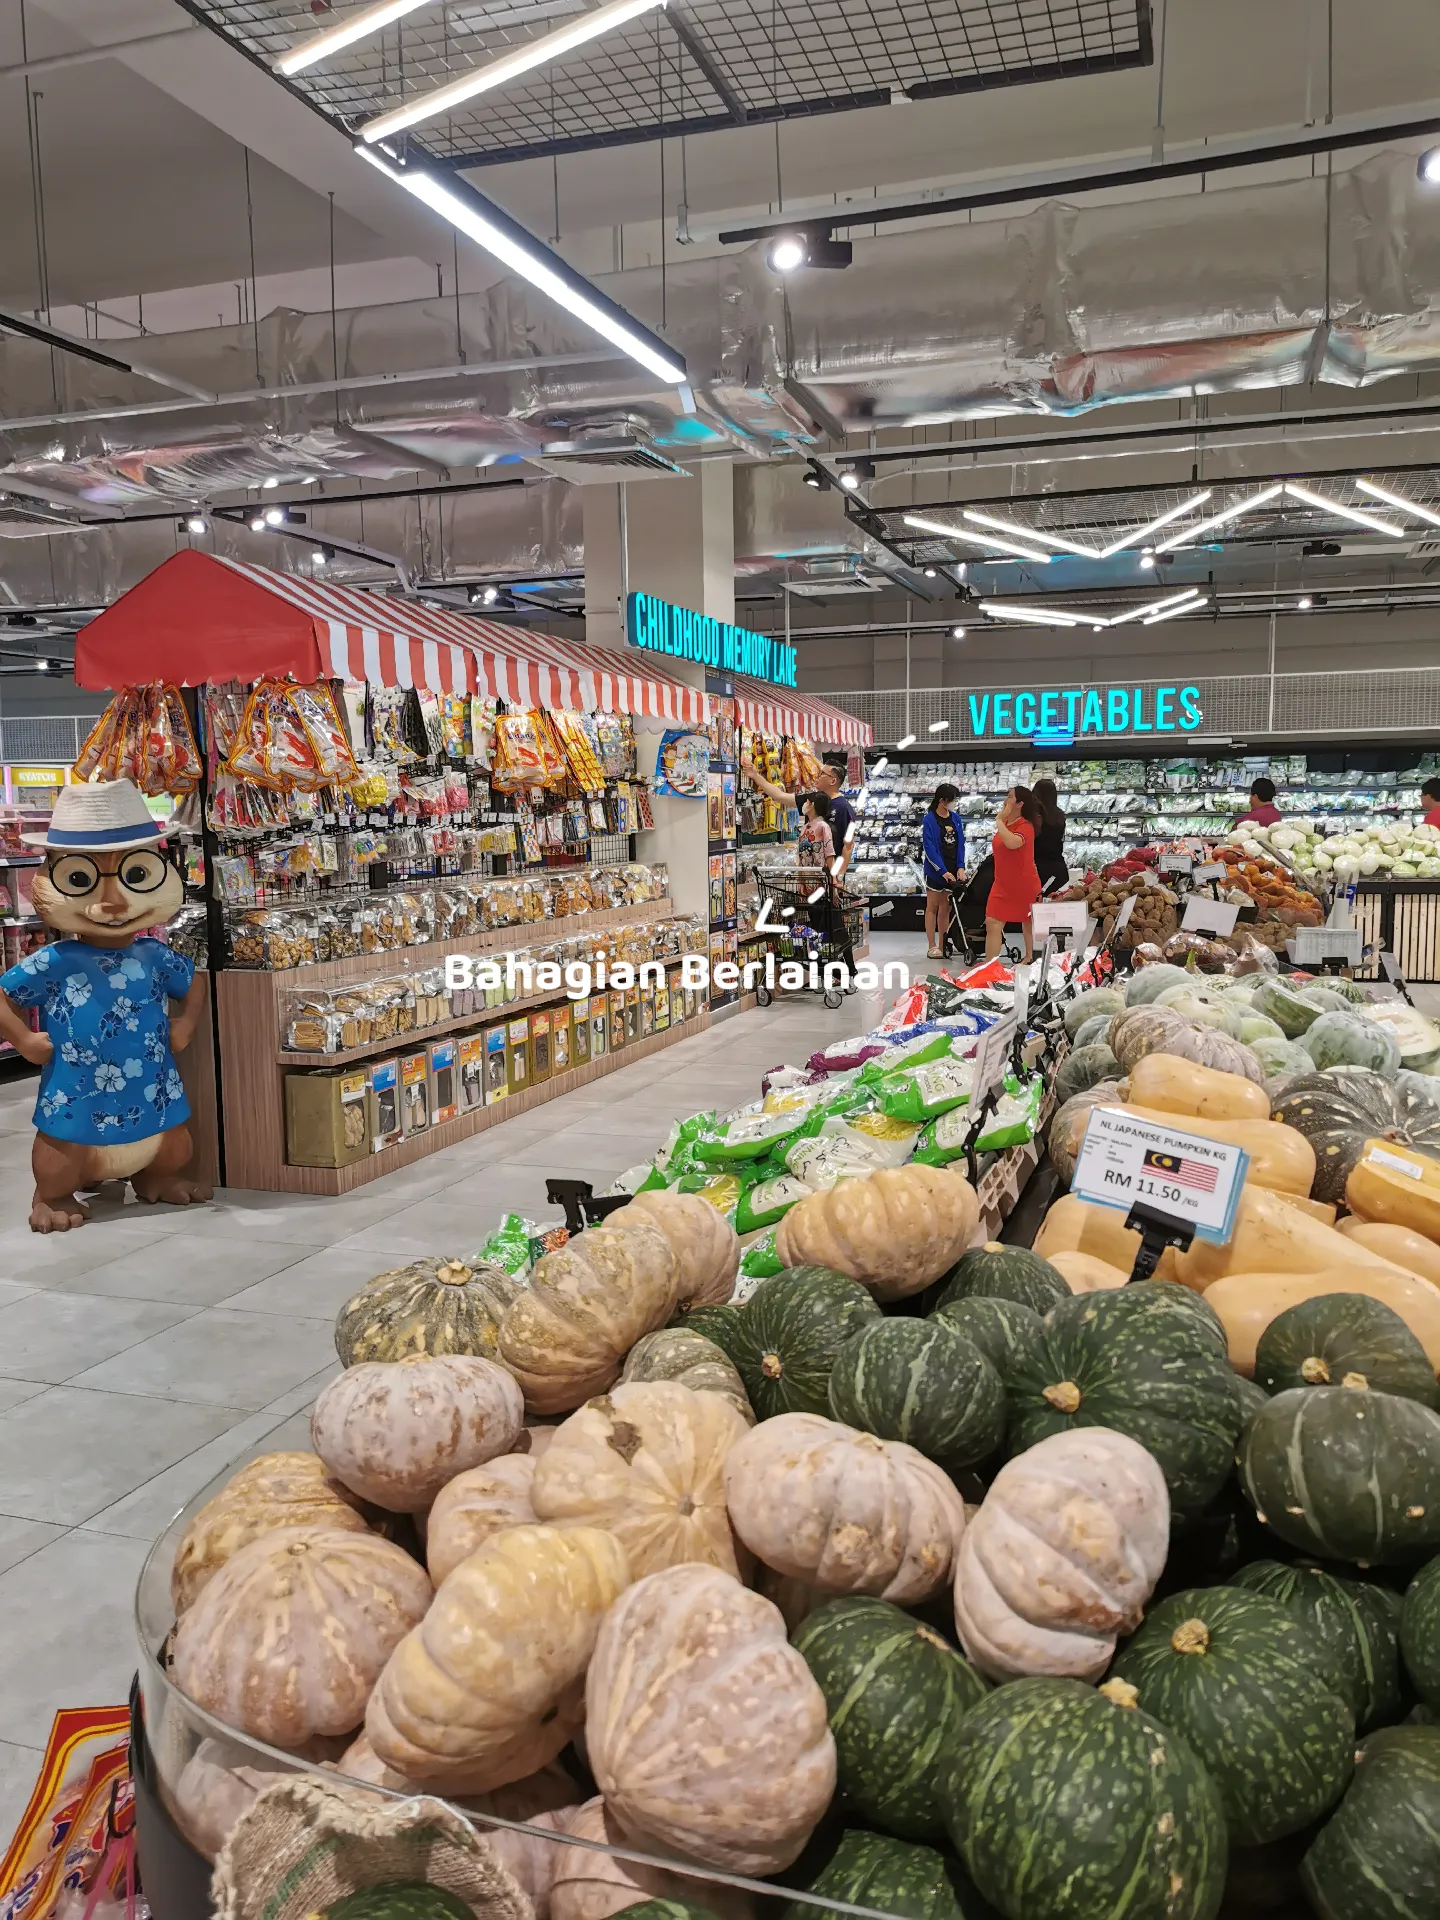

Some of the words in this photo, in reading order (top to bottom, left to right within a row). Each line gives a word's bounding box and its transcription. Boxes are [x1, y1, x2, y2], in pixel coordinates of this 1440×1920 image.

[635, 592, 719, 665] CHILDHOOD
[723, 624, 771, 679] MEMORY
[774, 641, 797, 688] LANE
[968, 686, 1201, 735] VEGETABLES
[1100, 1120, 1114, 1131] NL
[1113, 1124, 1162, 1144] JAPANESE
[1164, 1136, 1212, 1158] PUMPKIN
[1212, 1149, 1227, 1162] KG
[1103, 1169, 1132, 1188] RM
[1135, 1178, 1182, 1203] 11.50
[1182, 1196, 1200, 1208] /KG
